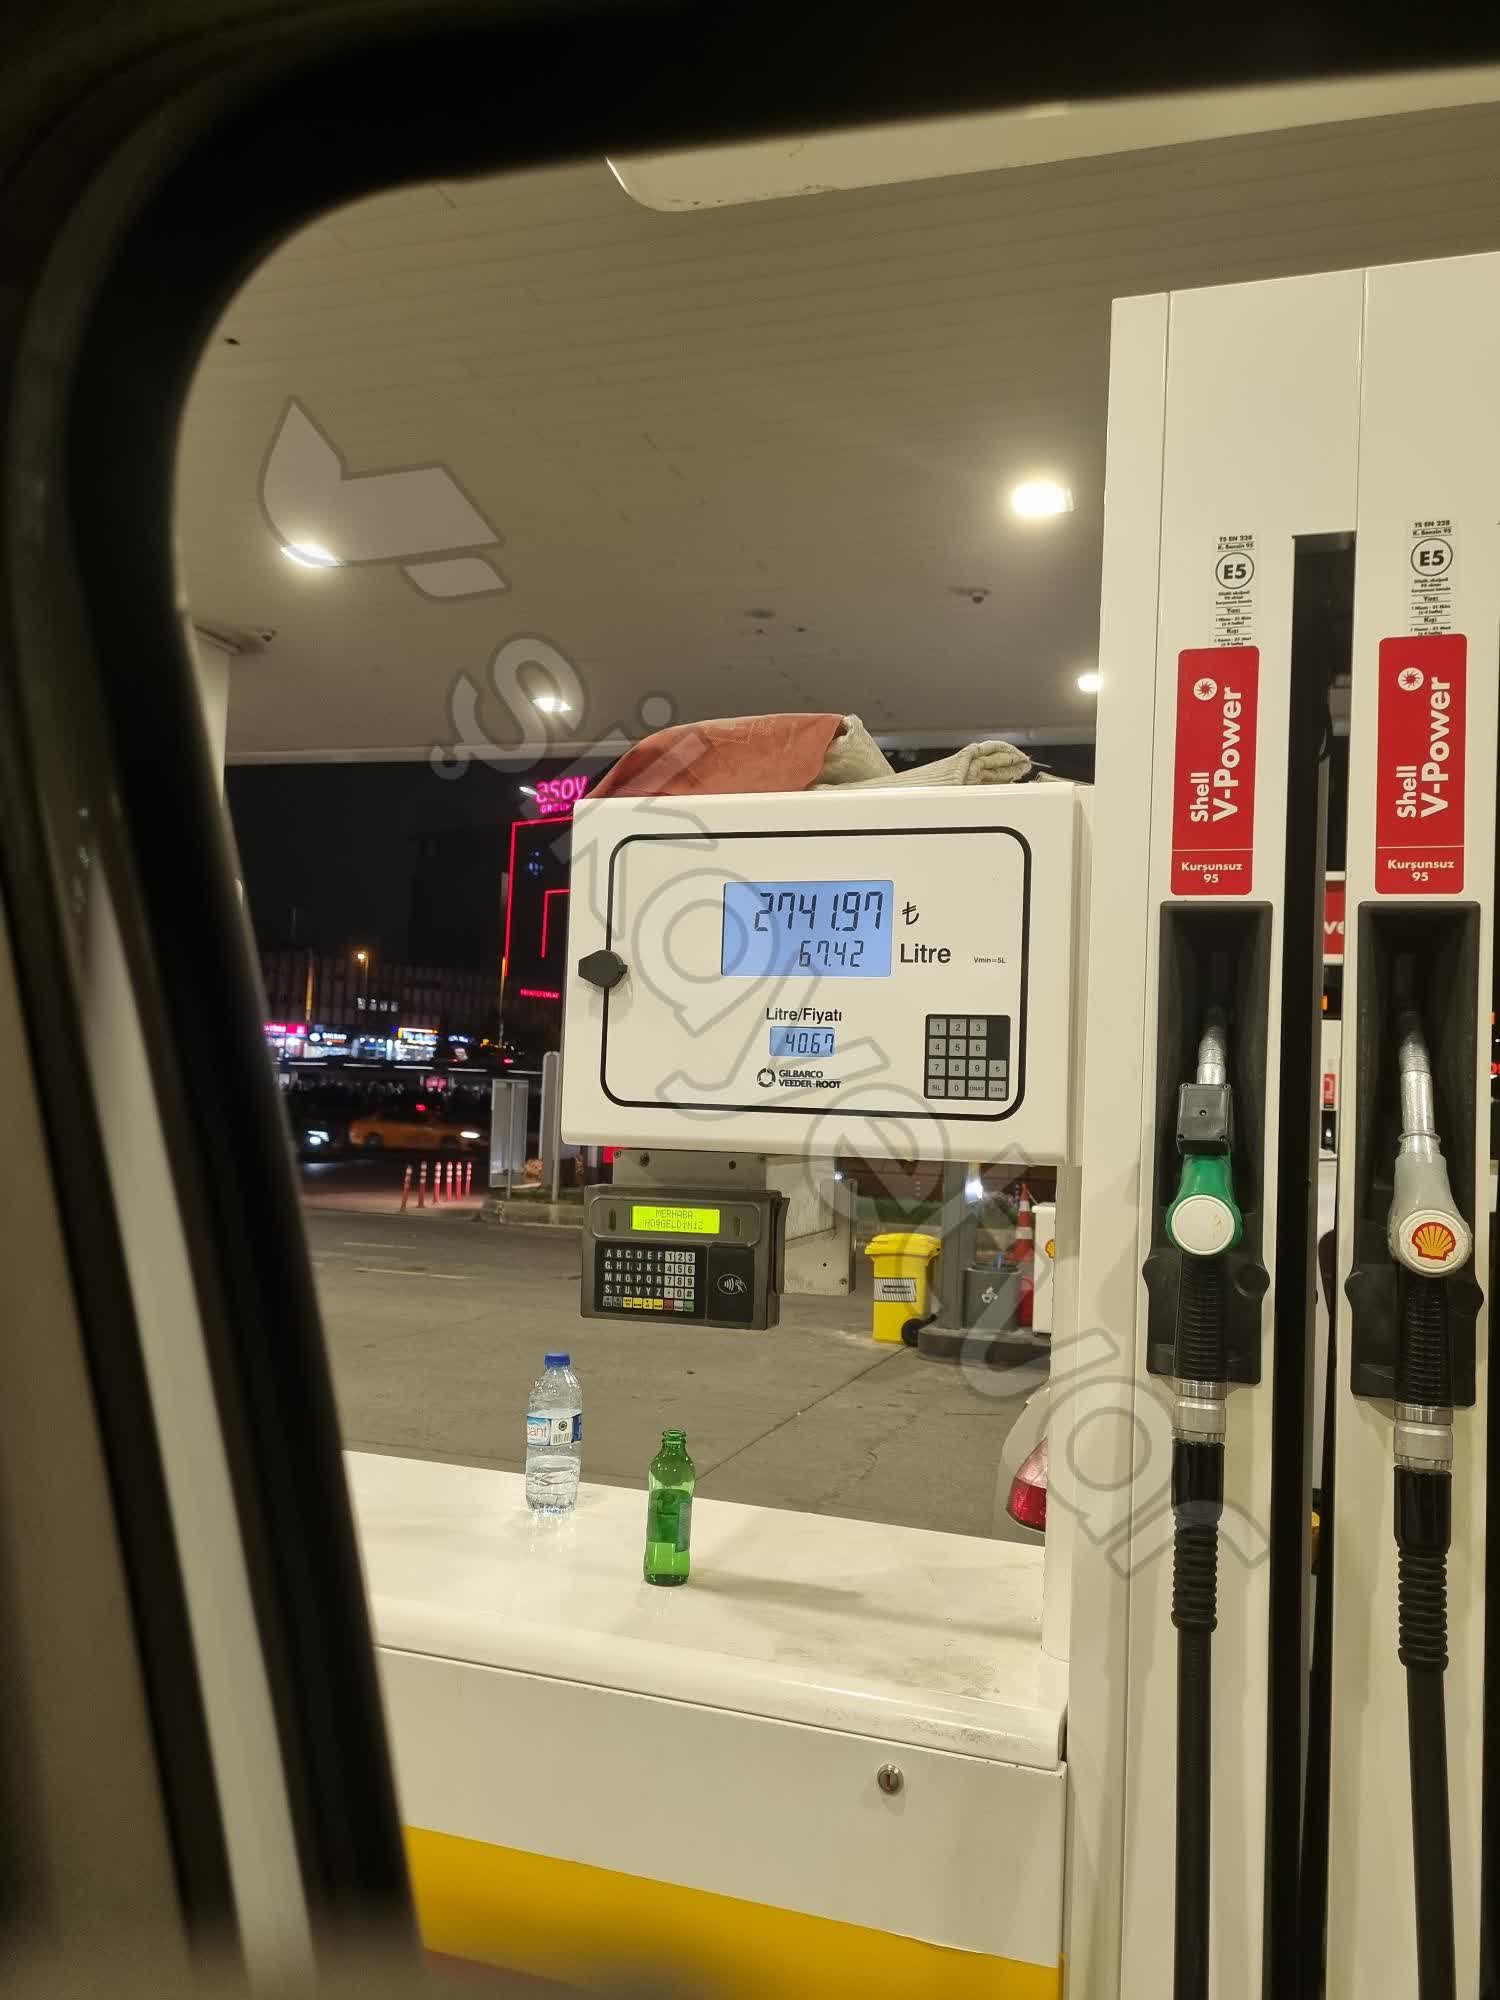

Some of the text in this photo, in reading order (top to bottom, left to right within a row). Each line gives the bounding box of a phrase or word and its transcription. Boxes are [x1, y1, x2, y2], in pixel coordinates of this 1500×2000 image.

[1419, 550, 1444, 567] E5
[1223, 564, 1247, 580] E5
[1421, 676, 1450, 818] V-Power
[1212, 686, 1242, 822] V-Power
[1190, 772, 1210, 822] Shell
[1396, 766, 1416, 818] Shell
[1182, 862, 1243, 874] Kurşunsuz
[1388, 860, 1455, 872] Kurşunsuz
[1204, 874, 1219, 883] 95
[1412, 872, 1429, 882] 95
[754, 891, 884, 932] 2741.97
[799, 940, 864, 968] 67.42
[900, 943, 952, 964] Litre
[766, 1008, 842, 1024] Litre/Fiyatı
[955, 1024, 960, 1032] 2
[976, 1024, 981, 1032] 3
[786, 1032, 834, 1054] 40.67
[934, 1044, 940, 1052] 4
[955, 1044, 960, 1052] 5
[778, 1070, 824, 1078] GILBARCO
[778, 1079, 842, 1088] VEEDER-ROOT
[656, 1208, 694, 1220] MERHABA
[606, 1249, 612, 1258] A
[616, 1250, 621, 1258] B
[637, 1251, 642, 1259] D
[647, 1251, 652, 1260] E
[658, 1252, 662, 1260] F
[616, 1263, 622, 1271] H
[636, 1263, 642, 1271] J
[646, 1263, 652, 1272] K
[657, 1264, 661, 1272] L
[604, 1273, 612, 1281] M
[616, 1273, 622, 1282] N
[636, 1275, 642, 1283] P
[636, 1287, 641, 1295] V
[646, 1287, 651, 1295] Y
[656, 1288, 661, 1296] Z
